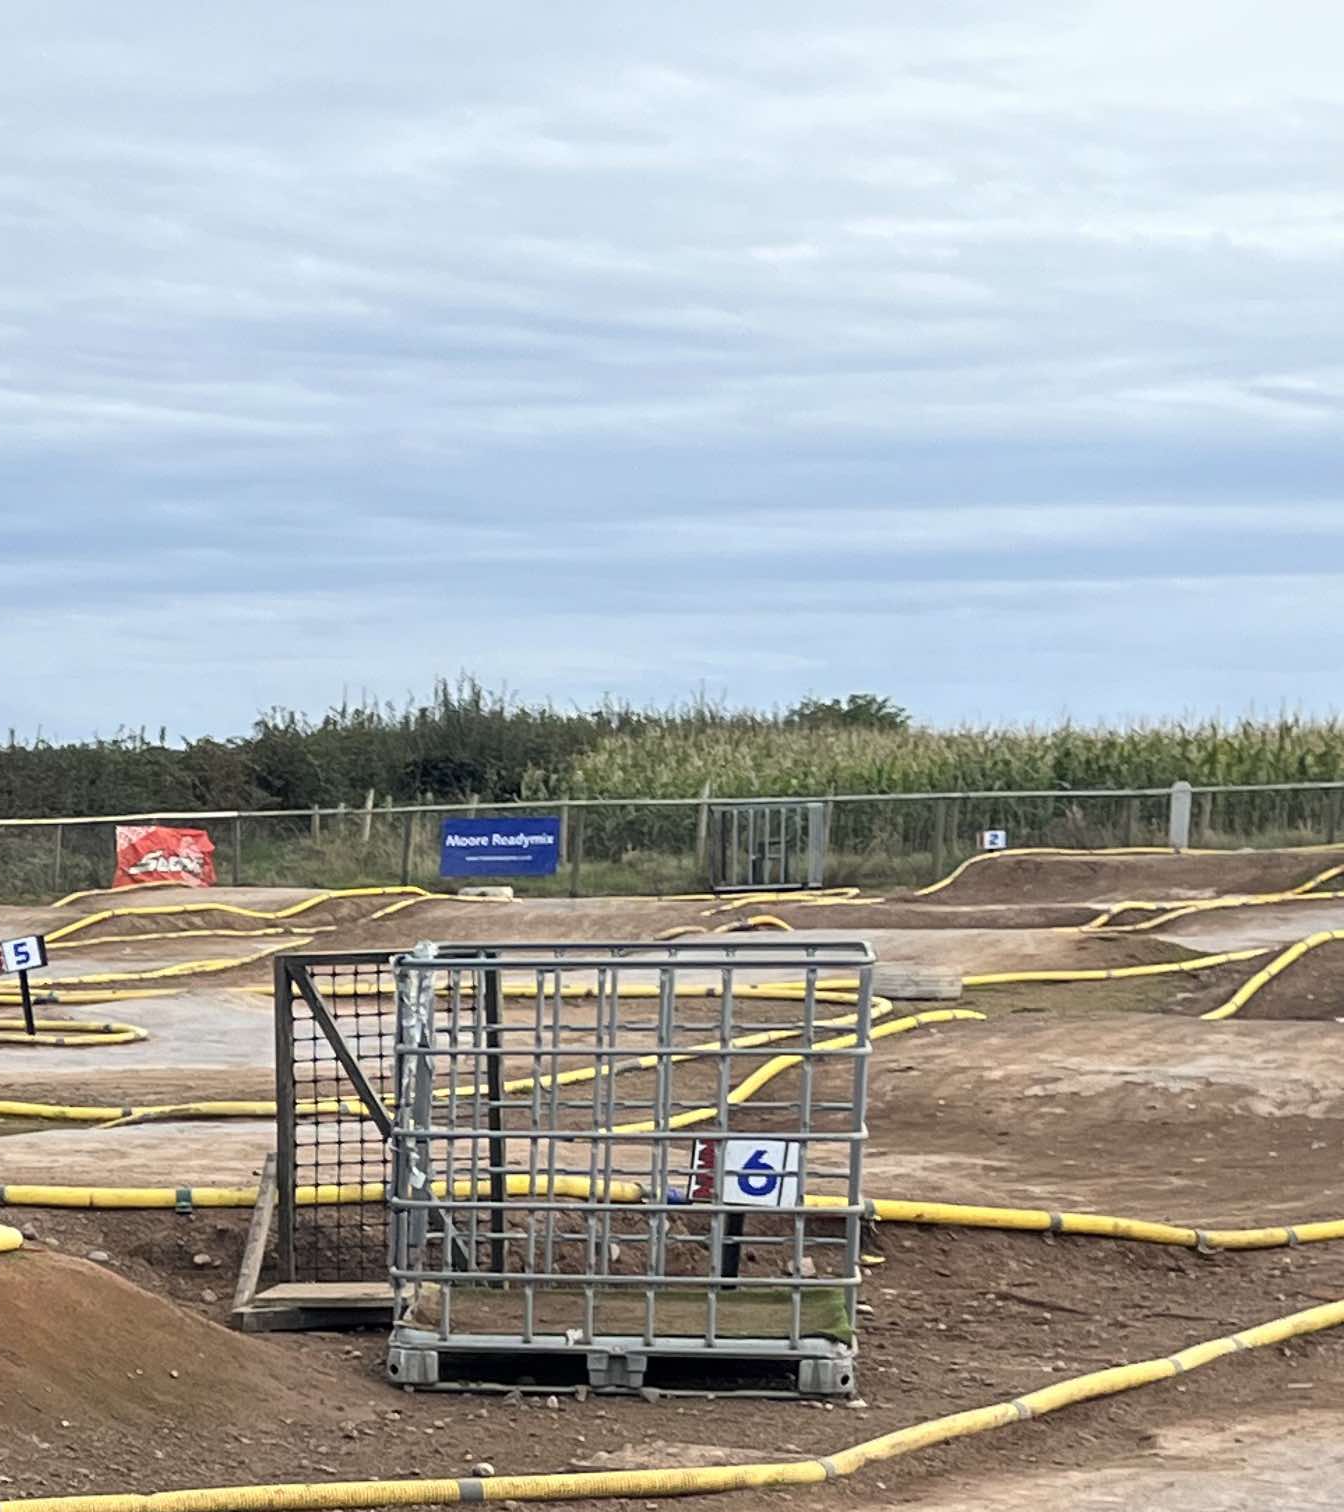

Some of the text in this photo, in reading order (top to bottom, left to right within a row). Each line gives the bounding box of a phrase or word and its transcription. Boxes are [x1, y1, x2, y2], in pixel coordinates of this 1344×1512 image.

[446, 832, 554, 848] Moore Readymix
[13, 942, 30, 965] 5
[737, 1149, 778, 1197] 6
